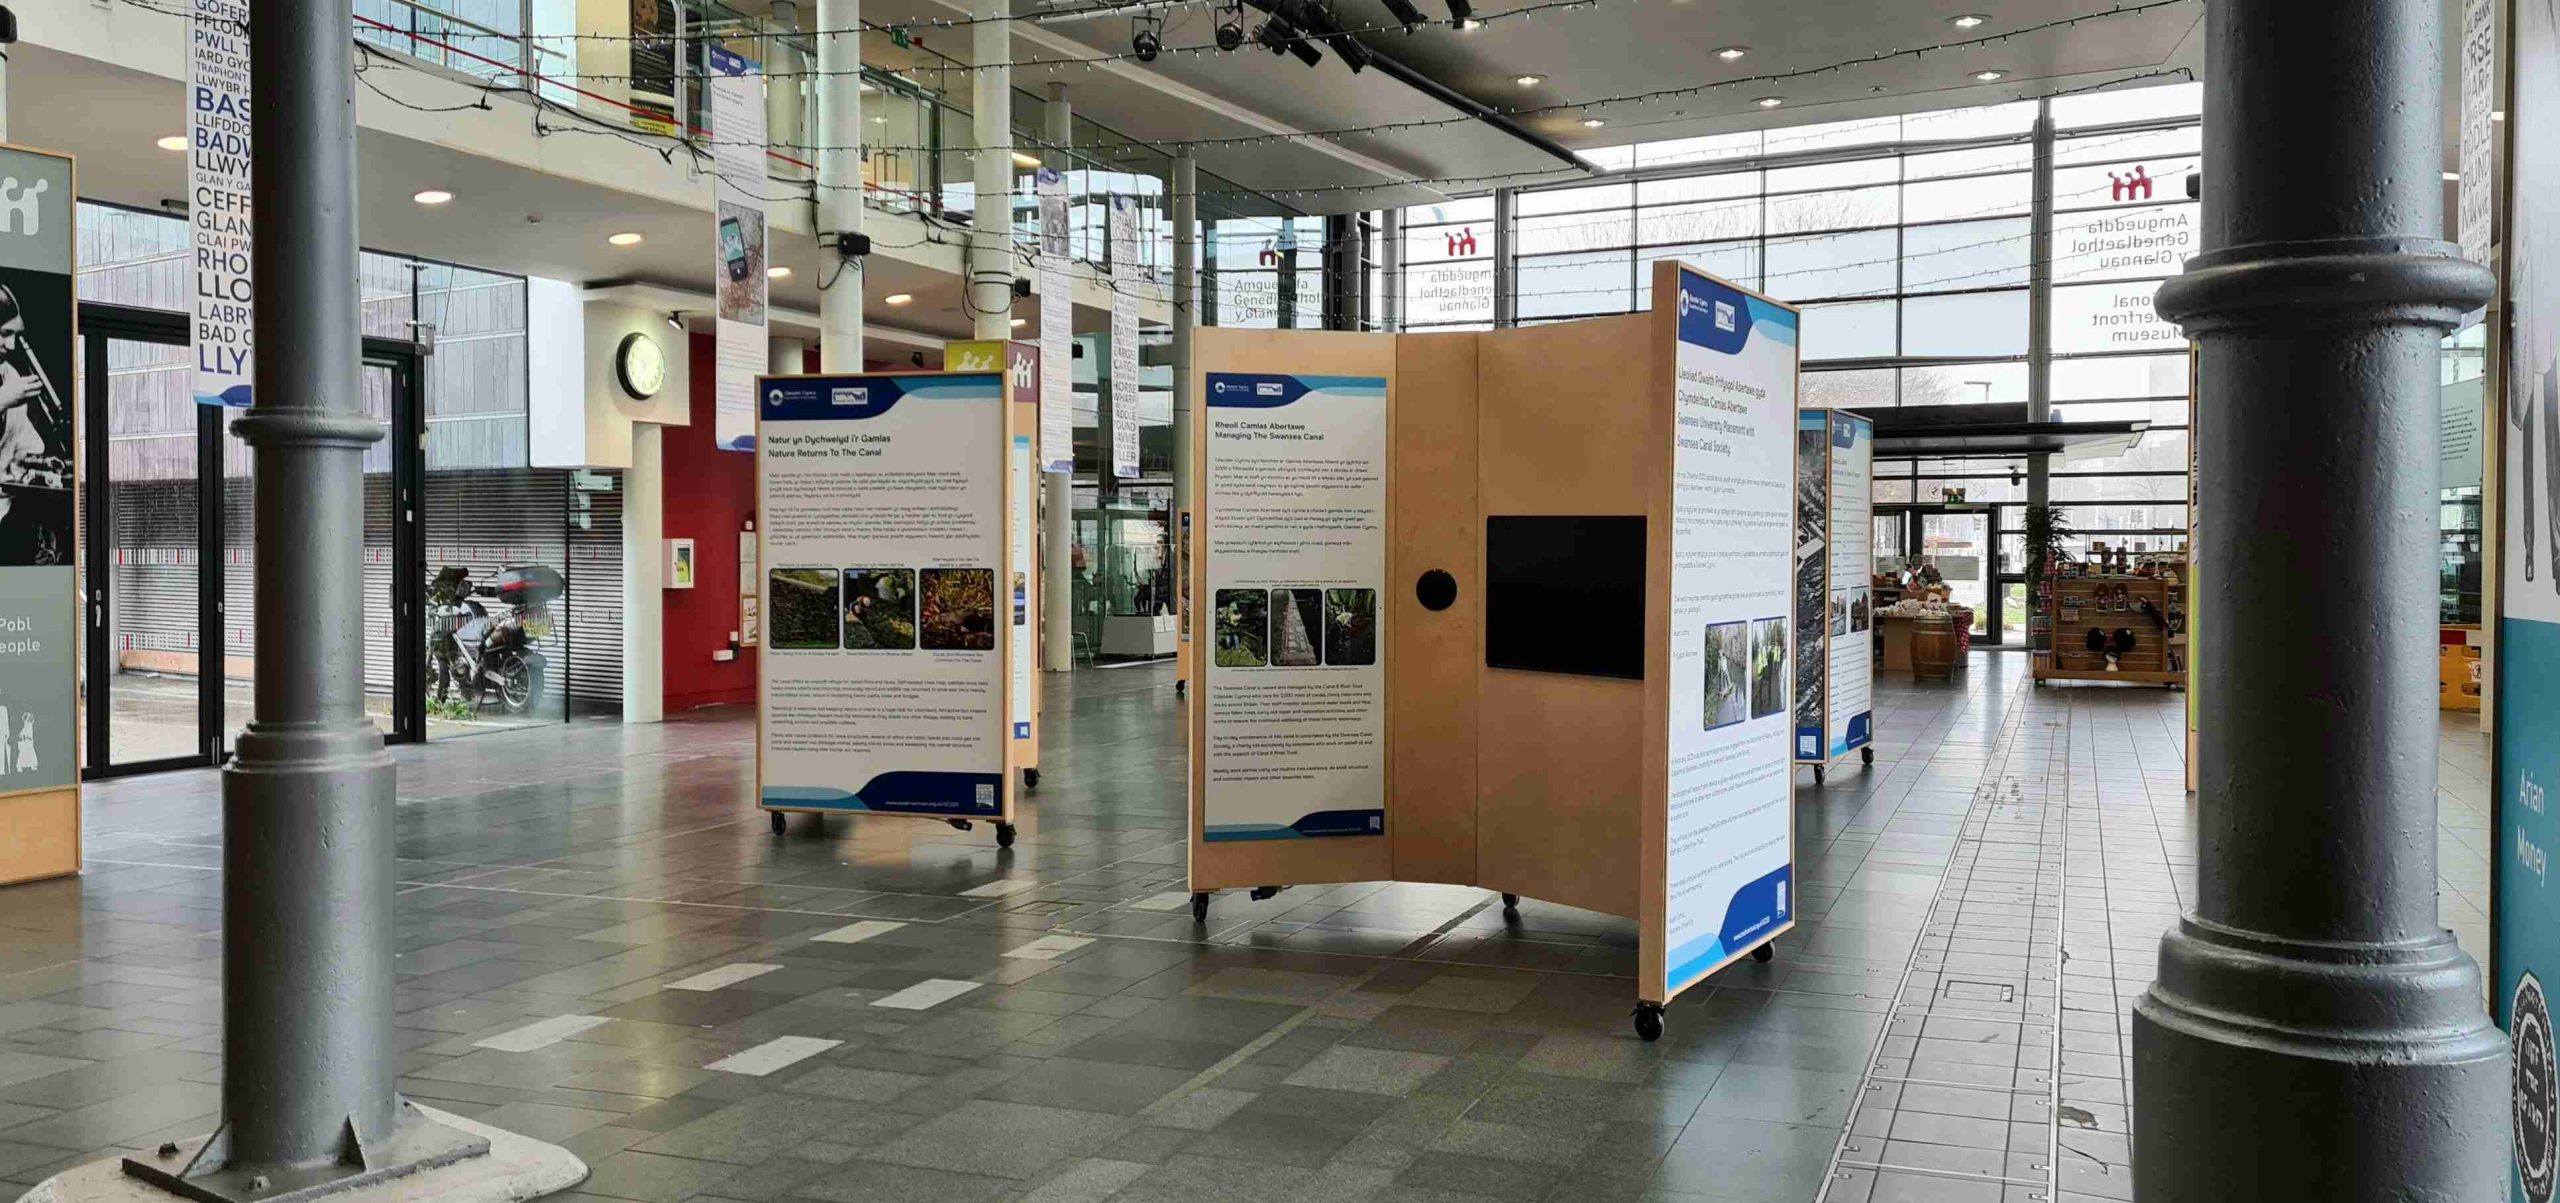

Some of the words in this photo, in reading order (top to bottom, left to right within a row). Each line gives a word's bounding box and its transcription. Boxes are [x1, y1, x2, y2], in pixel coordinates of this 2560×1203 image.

[194, 0, 249, 22] GOFER
[195, 30, 238, 54] PWLL
[195, 47, 223, 64] IARD
[196, 61, 247, 83] TRAPHONT
[196, 73, 240, 94] LLWYBR
[196, 172, 224, 187] GLAN
[227, 178, 233, 188] Y
[197, 232, 226, 248] CLAI
[198, 247, 248, 275] RHO
[198, 301, 252, 325] LABR
[199, 323, 236, 343] BAD
[200, 343, 251, 376] LLY
[768, 435, 790, 444] Natur
[792, 437, 803, 446] yn
[804, 434, 849, 446] Dychwelyd
[861, 434, 891, 443] Gamlas
[1215, 432, 1252, 440] Managing
[768, 448, 795, 458] Nature
[797, 448, 828, 457] Returns
[830, 448, 840, 457] To
[842, 448, 857, 457] The
[858, 448, 882, 457] Canal
[2520, 767, 2545, 817] Arian
[2517, 825, 2547, 888] Money
